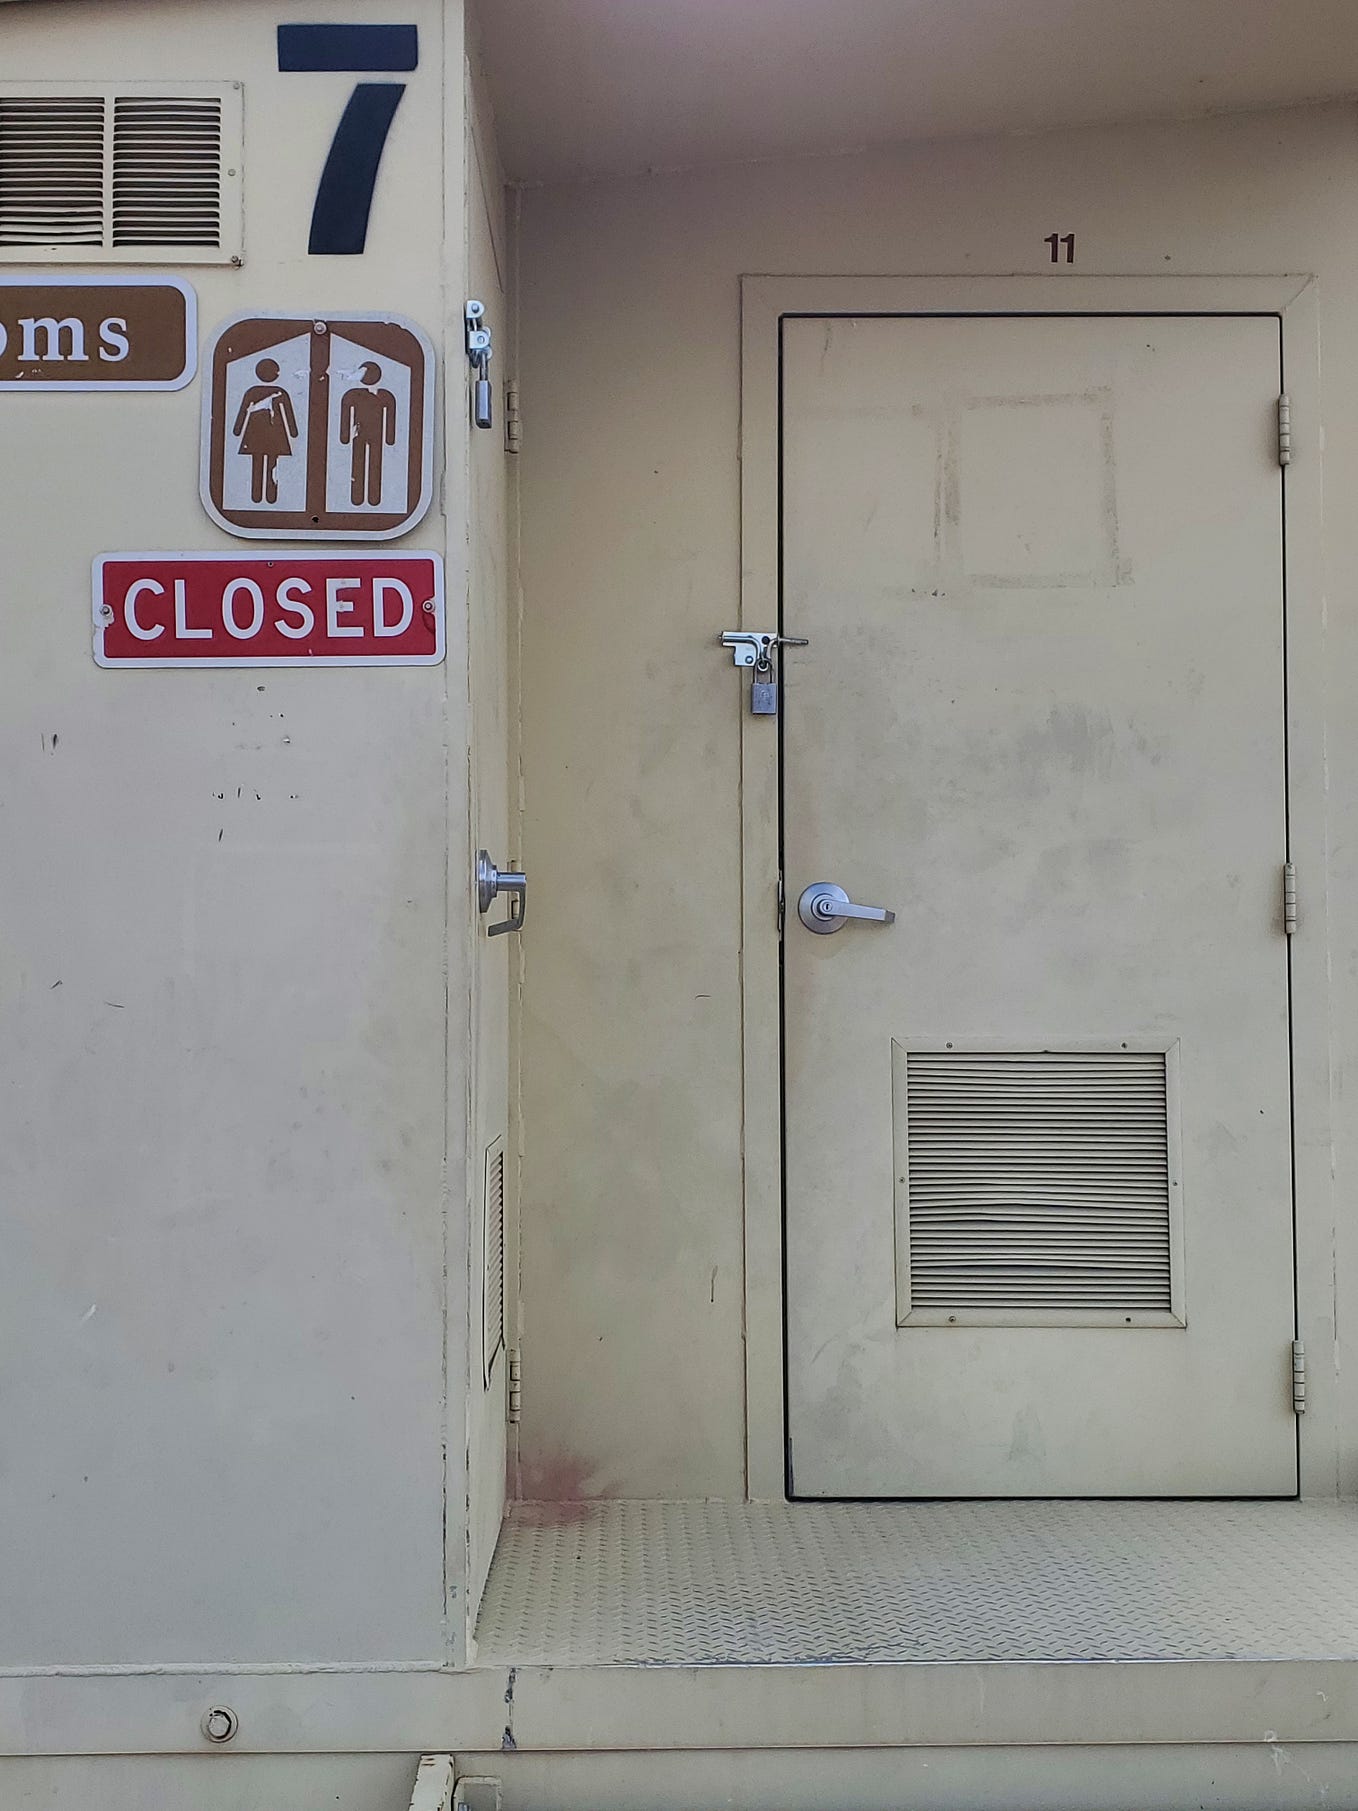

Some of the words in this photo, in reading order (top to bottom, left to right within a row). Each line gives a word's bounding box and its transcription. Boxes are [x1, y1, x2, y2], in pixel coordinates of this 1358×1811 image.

[277, 24, 418, 255] 7
[1044, 233, 1075, 263] 11
[0, 317, 129, 362] ms
[124, 577, 414, 641] CLOSED
